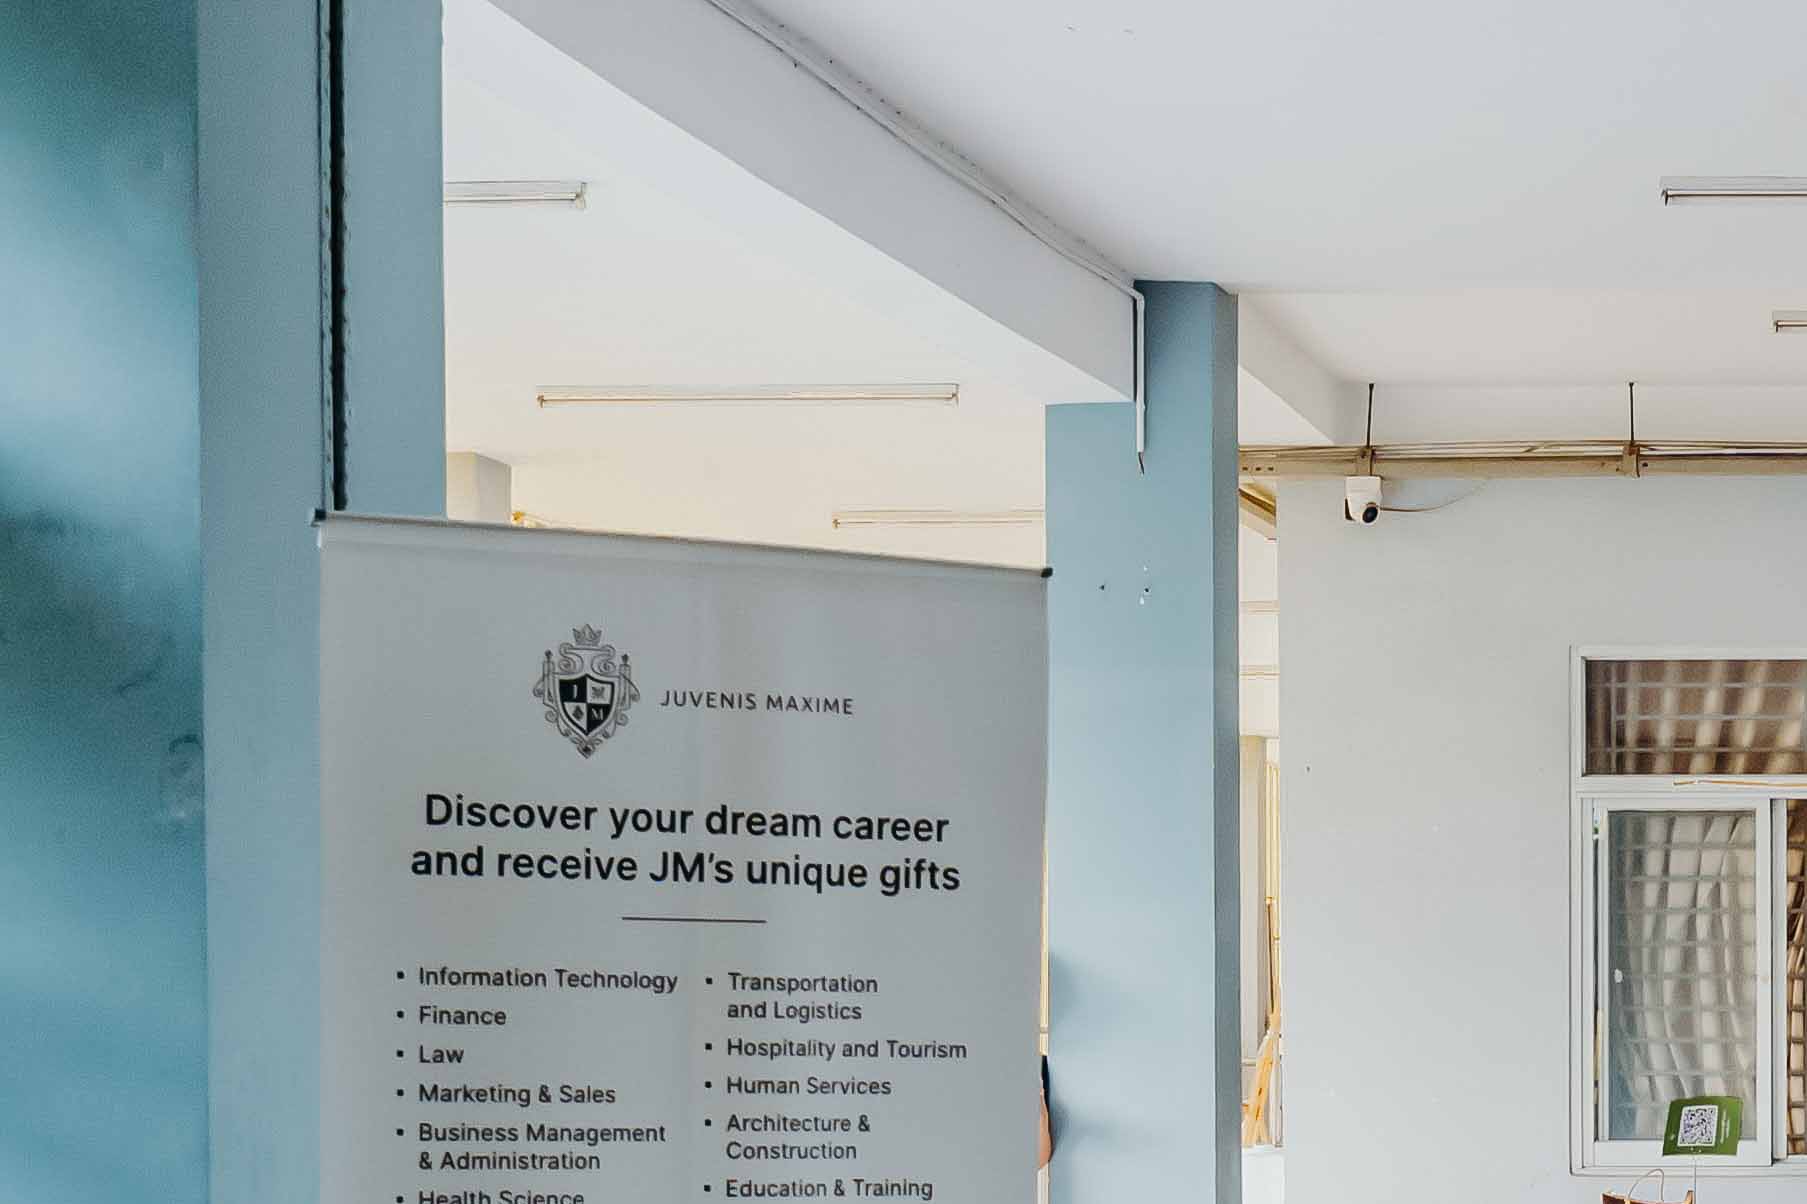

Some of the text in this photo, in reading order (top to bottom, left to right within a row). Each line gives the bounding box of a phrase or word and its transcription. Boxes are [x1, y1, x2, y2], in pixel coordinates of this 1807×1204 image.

[661, 690, 854, 715] JUVENIS MAXIME
[425, 793, 949, 842] Discover your dream career
[411, 845, 961, 897] and receive JM's unique gifts
[419, 966, 678, 994] Information Technology
[728, 972, 878, 995] Transportation
[419, 1005, 507, 1026] Finance
[727, 1000, 862, 1023] and Logistics
[419, 1044, 464, 1065] Law
[727, 1038, 967, 1062] Hospitality and Tourism
[419, 1084, 616, 1108] Marketing & Sales
[727, 1076, 892, 1096] Human Services
[419, 1122, 666, 1147] Business Management
[727, 1113, 871, 1133] Architecture &
[419, 1150, 601, 1171] & Administration
[726, 1140, 857, 1161] Construction
[726, 1178, 933, 1201] Education & Training
